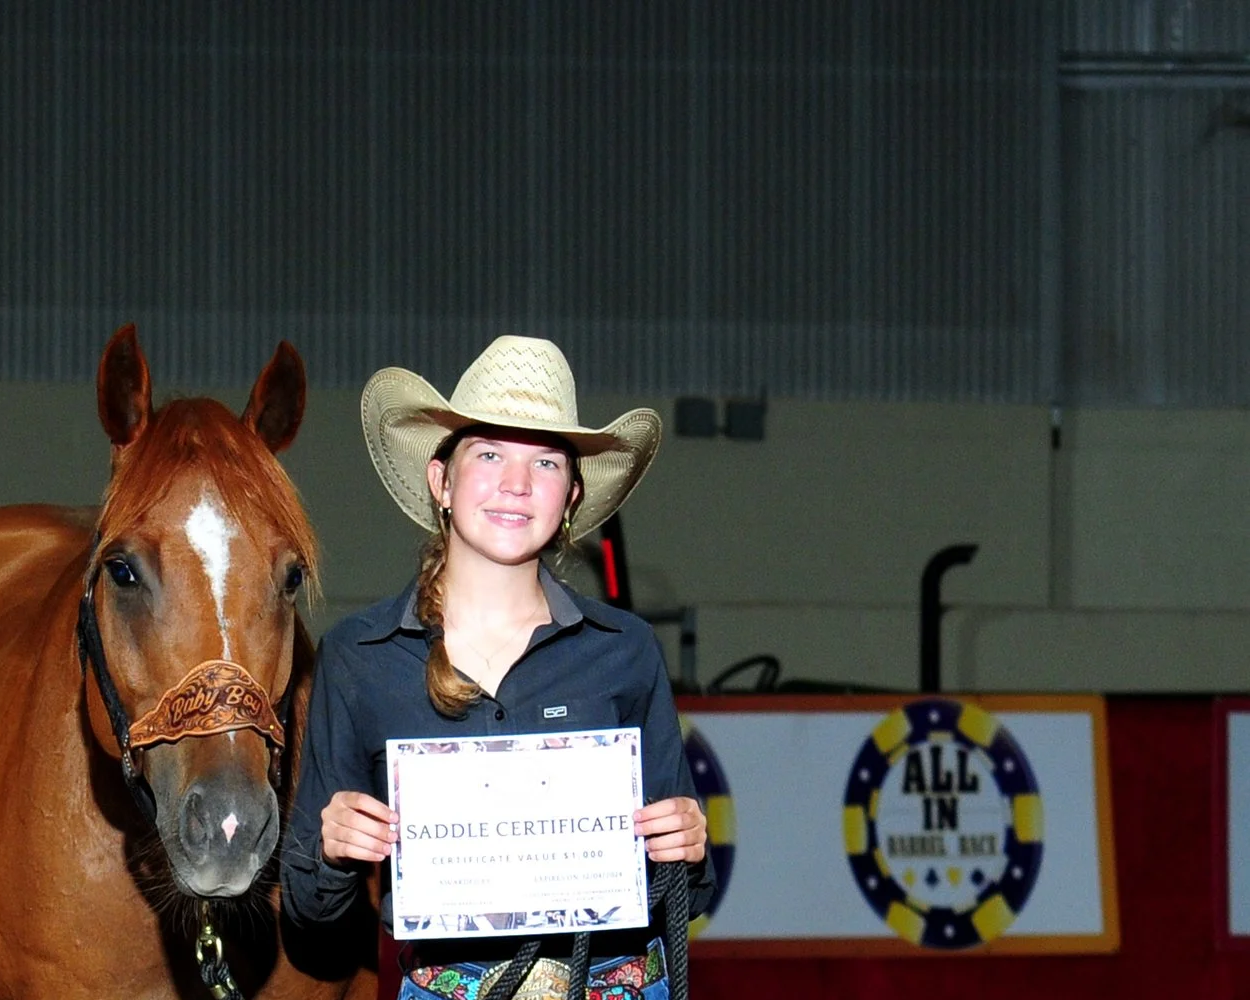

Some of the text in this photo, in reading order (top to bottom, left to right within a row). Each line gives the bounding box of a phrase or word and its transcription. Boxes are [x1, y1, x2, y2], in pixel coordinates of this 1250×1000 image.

[171, 685, 263, 724] Baby Boy
[901, 744, 980, 794] ALL
[406, 814, 630, 840] SADDLE CERTIFICATE
[923, 797, 959, 830] IN
[431, 854, 512, 865] CERTIFICATE
[517, 852, 557, 862] VALUE
